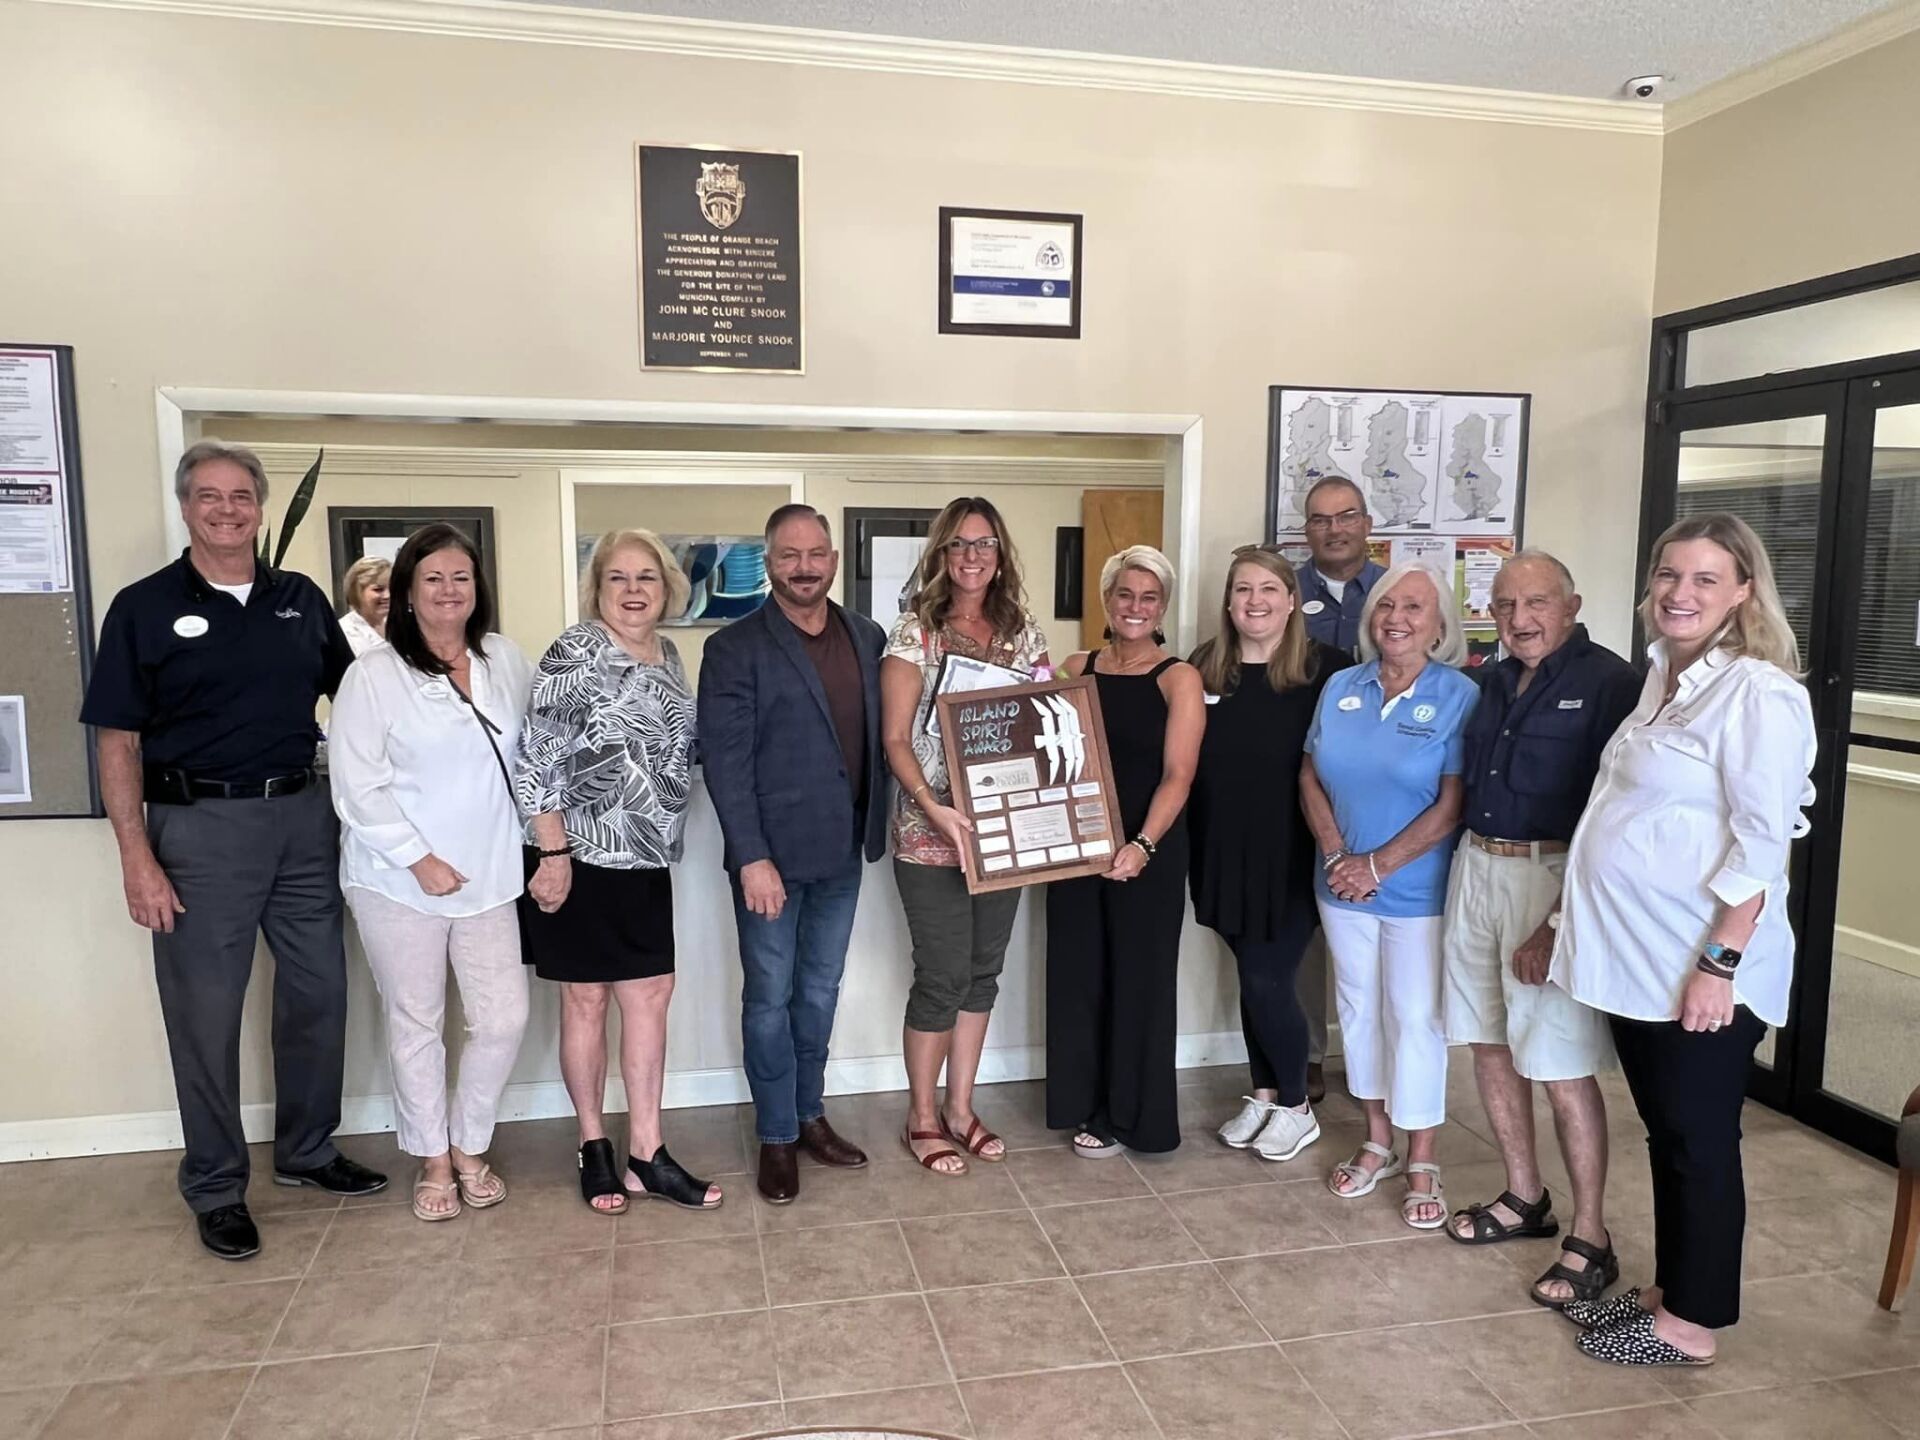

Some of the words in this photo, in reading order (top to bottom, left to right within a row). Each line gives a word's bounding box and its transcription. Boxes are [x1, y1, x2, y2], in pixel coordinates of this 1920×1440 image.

[681, 234, 707, 242] PEOPLE
[723, 236, 751, 244] ORANGE
[667, 246, 720, 254] ACKNOWLEDGE
[665, 258, 716, 266] APPRECIATION
[674, 270, 712, 278] GENEROUS
[679, 294, 718, 302] MUNICIPAL
[721, 295, 753, 303] COMPLEX
[659, 305, 687, 315] JOHN
[693, 306, 708, 316] MC
[712, 307, 745, 317] CLURE
[751, 308, 786, 318] SNOOK
[714, 321, 732, 329] AND
[652, 332, 706, 343] MARJORIE
[711, 333, 753, 344] YOUNCE
[758, 335, 793, 345] SNOOK
[960, 700, 1020, 723] ISLAND
[962, 720, 1015, 741] SPIRIT
[964, 738, 1012, 756] AWARD
